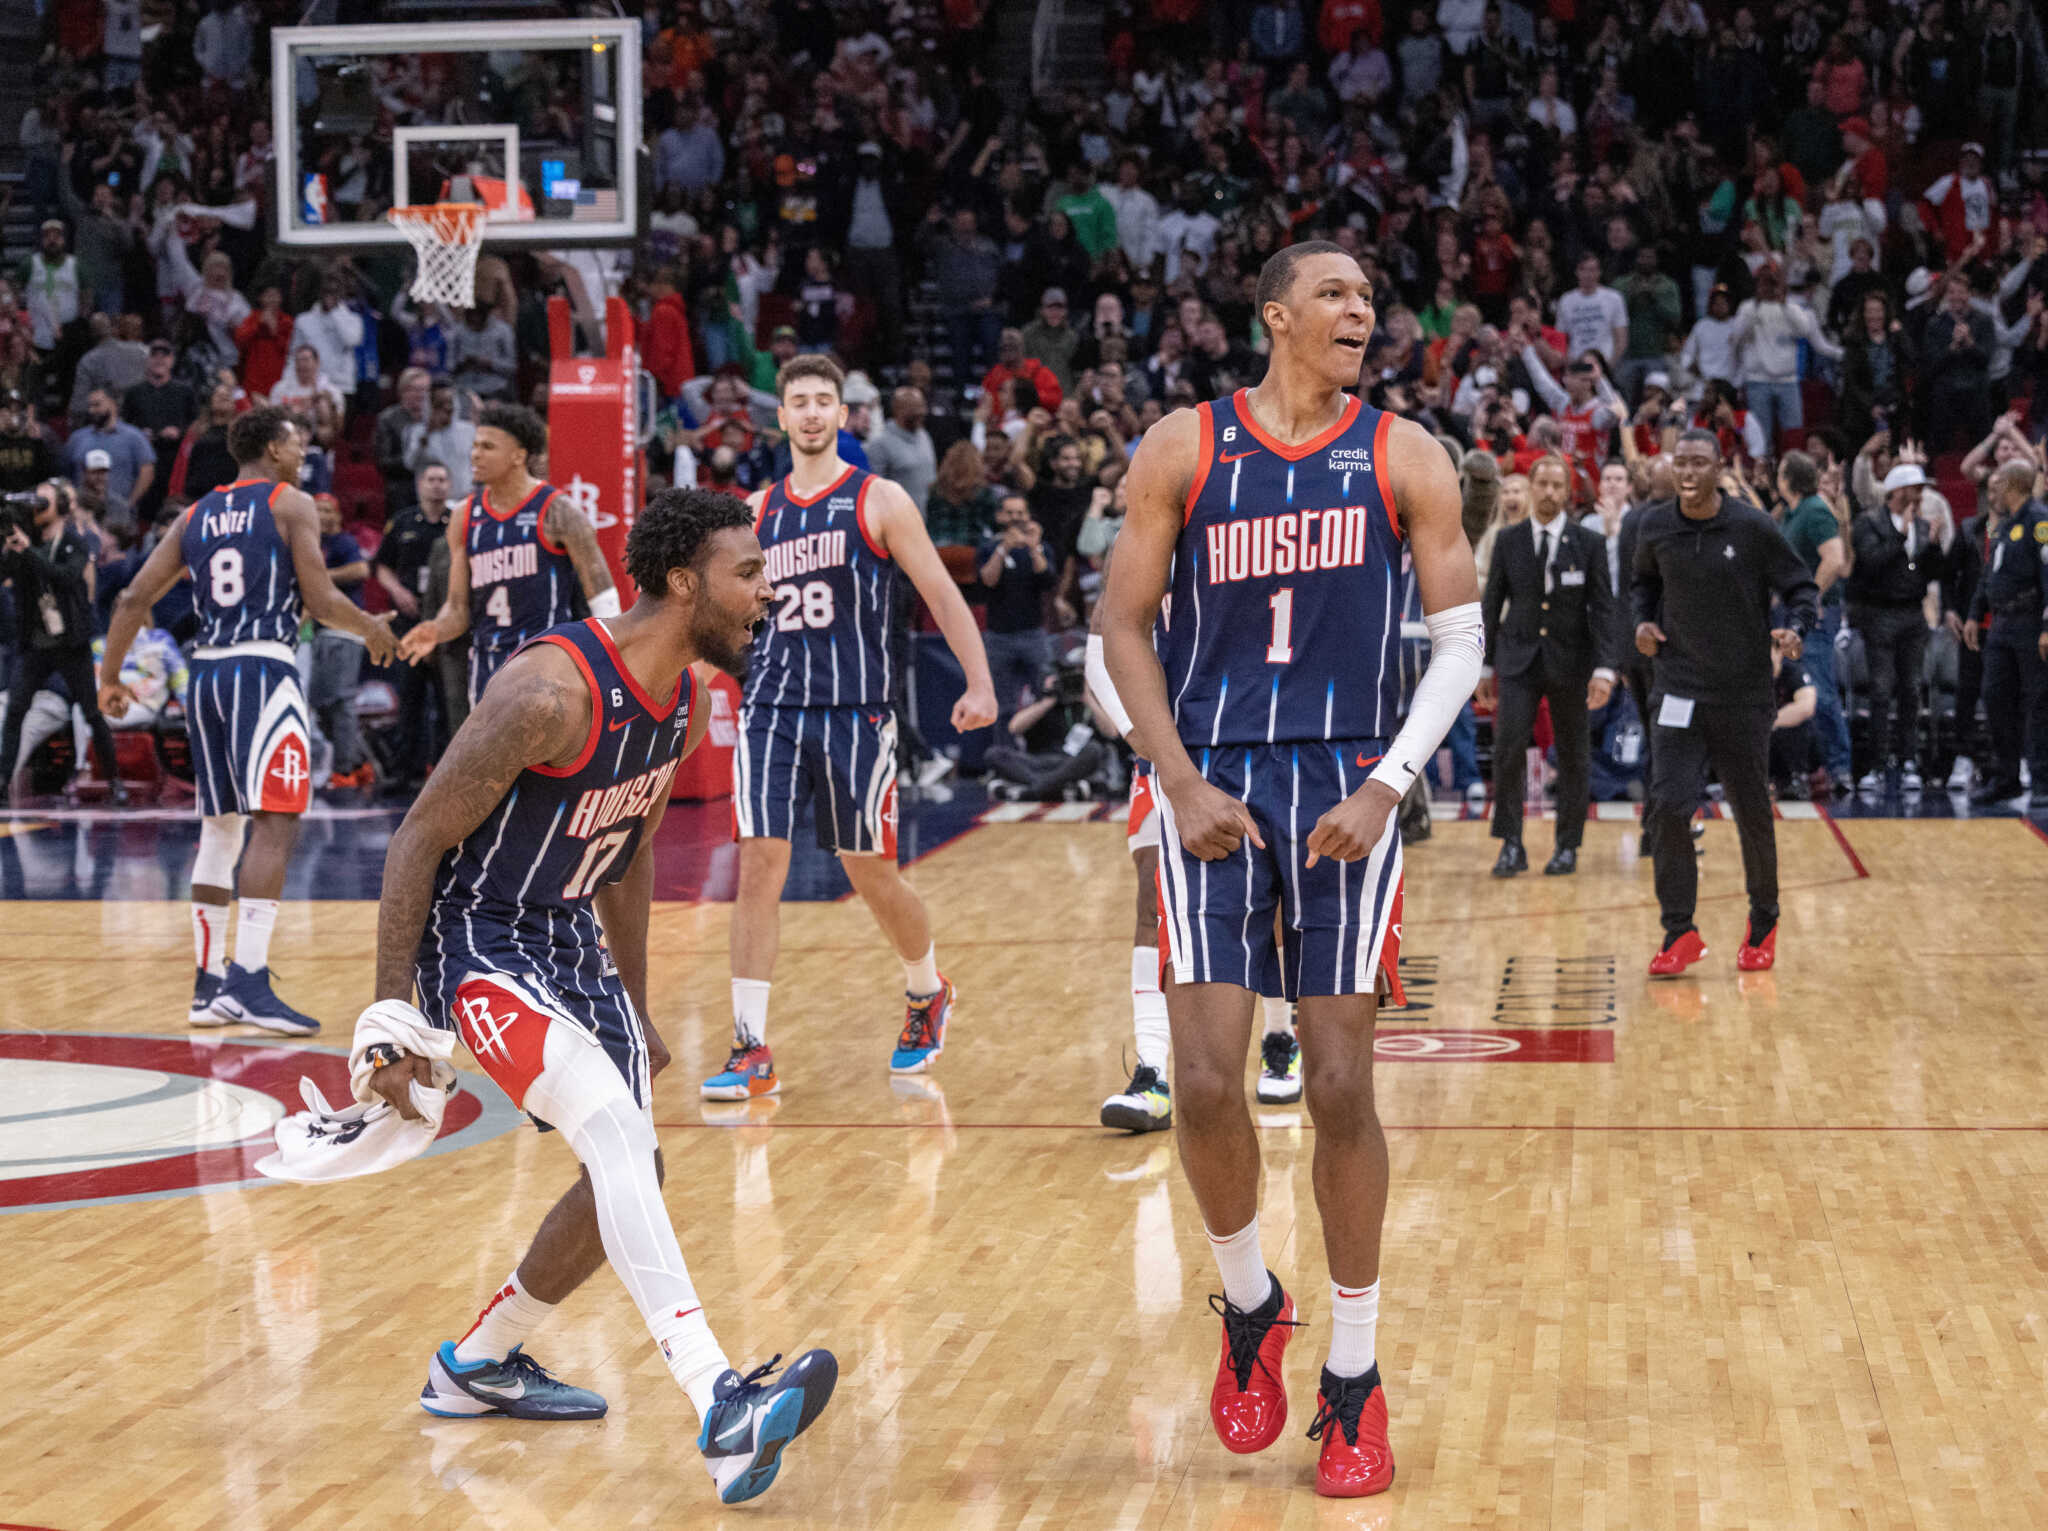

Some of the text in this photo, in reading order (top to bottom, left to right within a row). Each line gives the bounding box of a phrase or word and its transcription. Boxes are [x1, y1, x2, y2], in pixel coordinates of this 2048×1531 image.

[1222, 425, 1237, 442] 6
[1331, 448, 1369, 460] credit
[1328, 458, 1372, 472] karma
[210, 547, 245, 607] 8
[486, 586, 512, 627] 4
[774, 580, 835, 632] 28
[1265, 587, 1294, 664] 1
[611, 687, 623, 708] 6
[562, 829, 633, 900] 17
